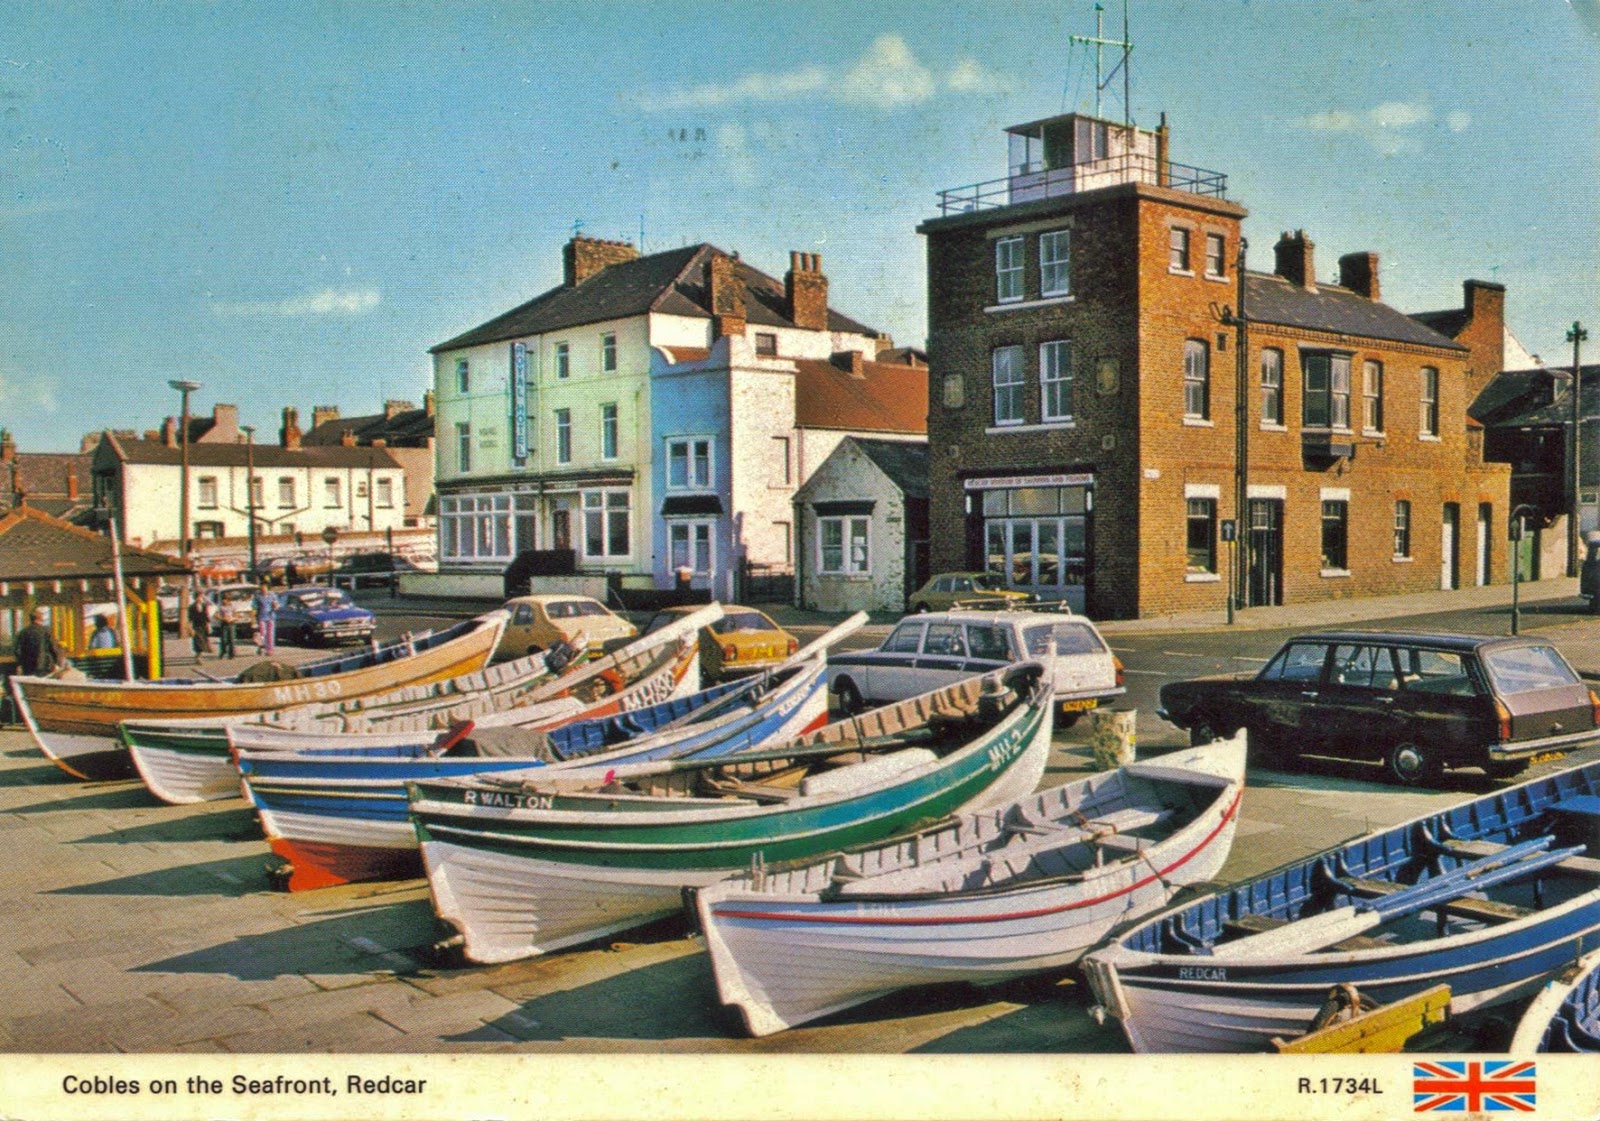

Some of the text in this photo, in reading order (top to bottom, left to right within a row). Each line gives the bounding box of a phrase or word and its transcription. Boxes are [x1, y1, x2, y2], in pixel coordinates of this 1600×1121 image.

[514, 404, 527, 457] HOTEL
[464, 790, 554, 811] R WALTON
[1179, 967, 1227, 981] REDCAR
